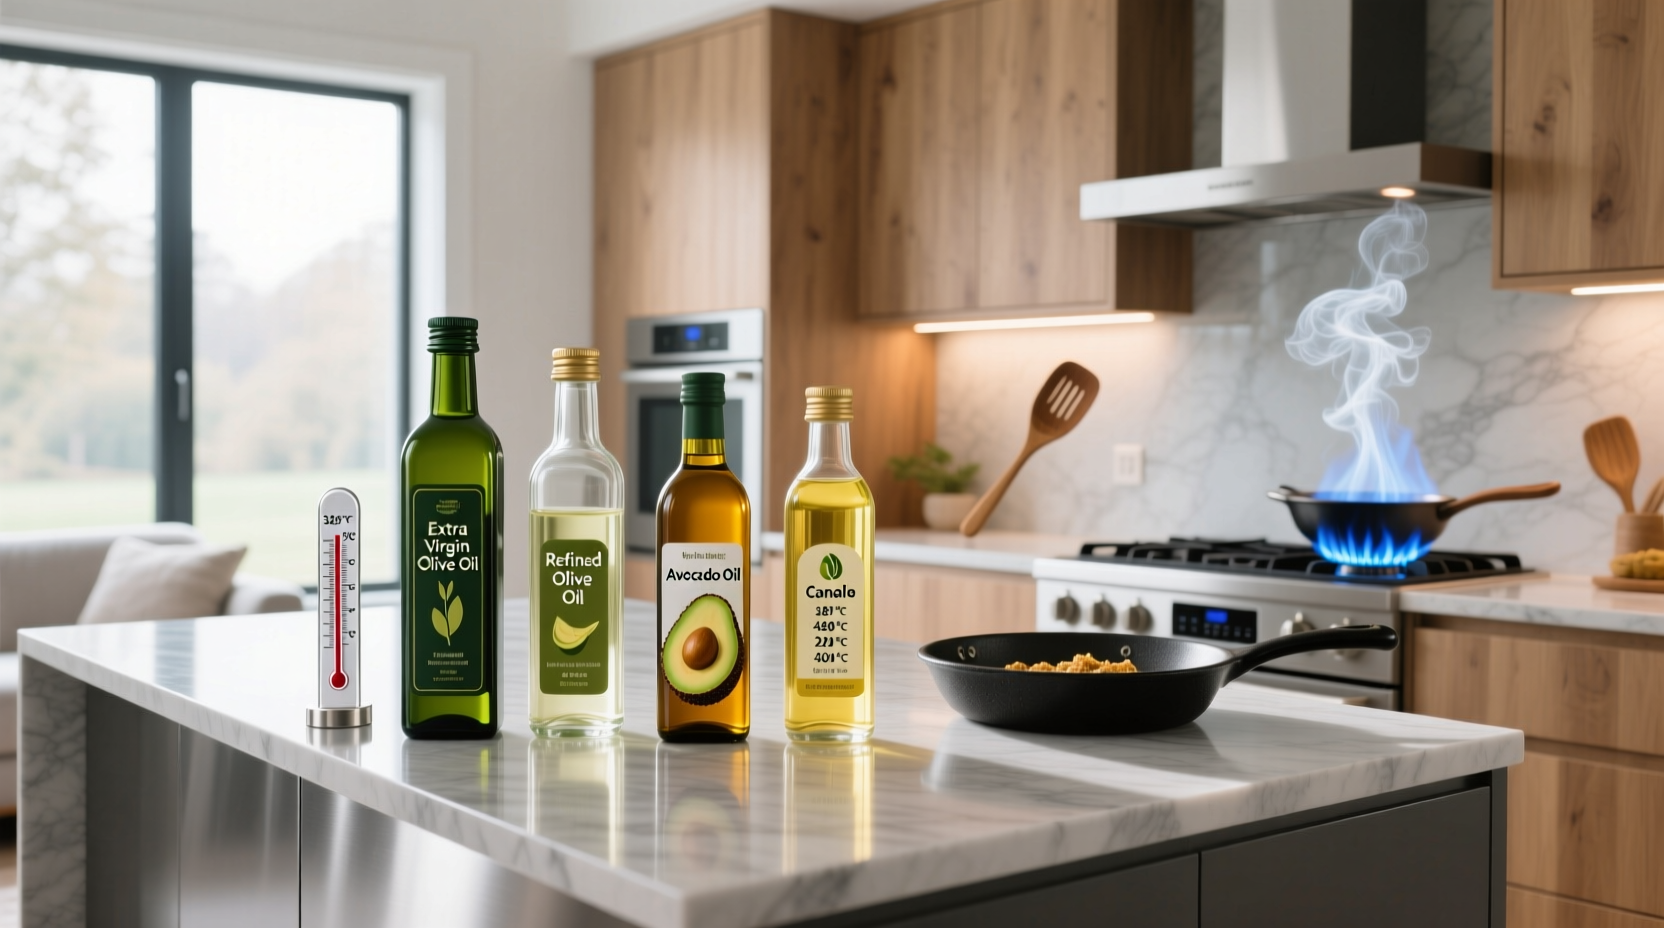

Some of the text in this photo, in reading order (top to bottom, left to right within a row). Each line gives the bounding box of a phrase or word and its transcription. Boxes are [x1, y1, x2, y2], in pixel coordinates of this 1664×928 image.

[428, 521, 468, 536] Extra
[424, 539, 470, 557] Virgin
[417, 555, 479, 571] Olive Oil
[545, 551, 602, 567] Refined
[552, 570, 593, 586] Olive
[666, 567, 741, 581] Avocado Oil
[562, 589, 584, 605] Oil
